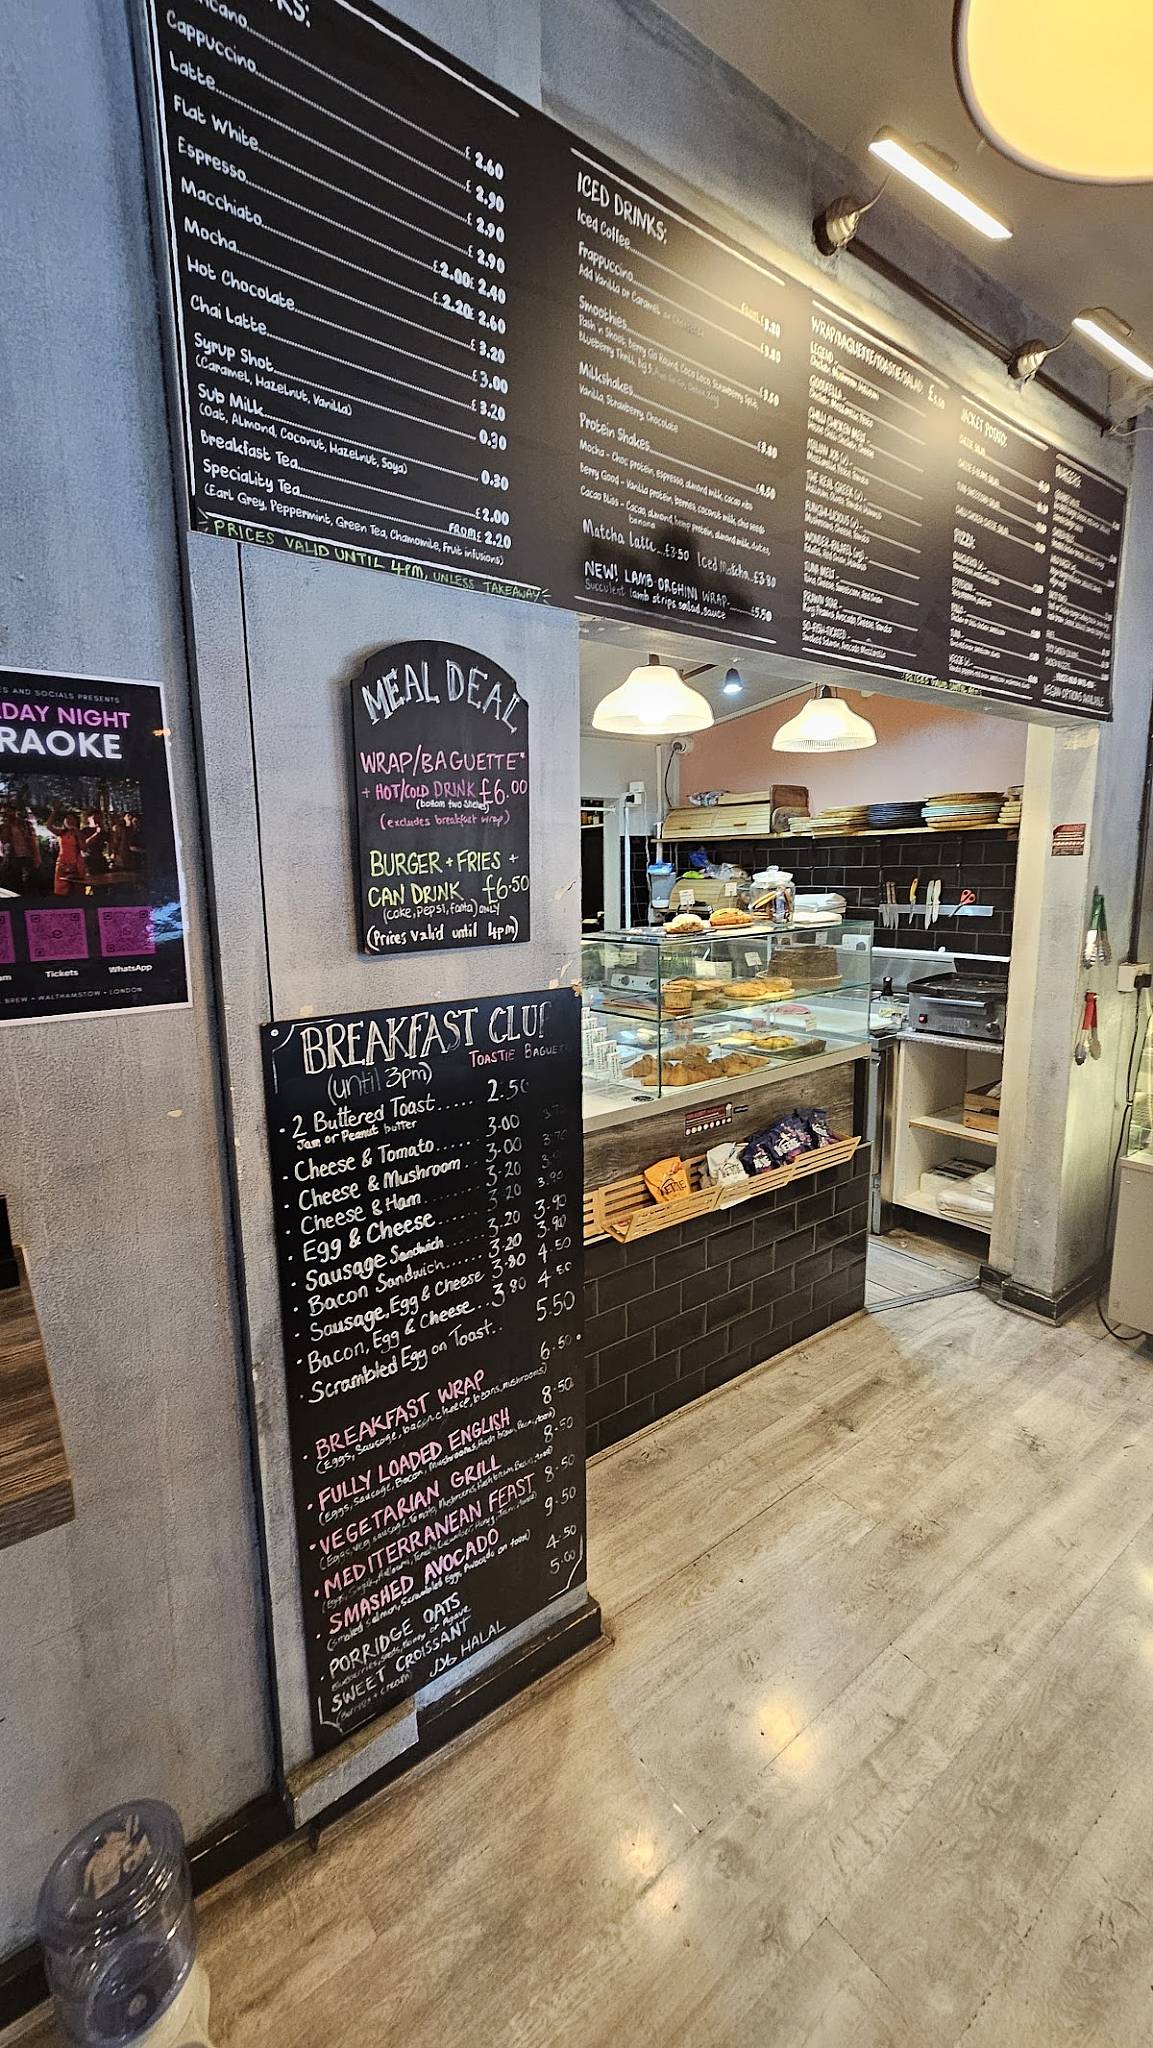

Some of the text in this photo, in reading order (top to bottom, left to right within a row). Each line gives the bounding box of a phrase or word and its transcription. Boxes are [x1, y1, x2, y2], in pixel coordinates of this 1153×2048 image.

[166, 9, 257, 74] Cappuccino
[169, 50, 216, 91] Latte
[173, 95, 259, 152] Flat White
[177, 135, 247, 183] Espresso
[181, 177, 262, 227] Macchiato
[576, 171, 610, 208] ICED
[184, 216, 238, 253] Mocha
[186, 255, 296, 311] Hot Chocolate
[578, 241, 634, 282] Frappuccino
[190, 294, 268, 336] Chai Latte
[578, 294, 627, 330] Smoothies
[194, 332, 507, 451] Syrup Shot 0.30
[312, 393, 352, 417] Vanilla)
[198, 383, 509, 491] Sub Milk 0.30
[579, 412, 615, 438] Protein
[200, 429, 271, 462] Breakfast
[275, 450, 299, 470] Tea
[381, 456, 408, 475] Soya)
[203, 459, 300, 497] Speciality Tea
[335, 516, 367, 533] Green
[582, 518, 625, 545] Matcha
[214, 519, 275, 545] PRICES
[284, 536, 329, 557] VALID
[334, 548, 383, 570] UNTIL
[433, 571, 474, 589] UNLESS
[482, 581, 542, 601] TAKEAWAY
[0, 702, 131, 729] DAY NIGHT
[12, 687, 120, 703] AND SOCIALS PRESENTS
[361, 659, 521, 734] MEAL DEAL
[433, 779, 476, 798] DRINK
[479, 777, 528, 806] £6.00
[380, 810, 511, 831] (excludes breakfast wrap)
[369, 849, 501, 877] BURGER FRIES
[368, 874, 530, 908] CAN DRINK £6.50
[366, 925, 407, 952] (Prices
[452, 921, 478, 938] until
[487, 915, 519, 941] 4pm)
[45, 964, 153, 978] Tickets WhatsApp
[38, 987, 143, 1001] WALTHAMSTOW LONDON
[299, 1006, 479, 1076] BREAKFAST
[469, 1047, 516, 1068] TOASTIE
[327, 1061, 433, 1107] (until 3pm)
[291, 1114, 308, 1139] 2
[313, 1103, 384, 1134] Buttered
[390, 1092, 436, 1117] Toast
[296, 1118, 417, 1151] Jam or Peanut butter
[294, 1157, 356, 1183] Cheese
[380, 1138, 435, 1163] Tomato
[298, 1180, 361, 1211] Cheese
[383, 1158, 461, 1190] Mushroom
[300, 1204, 366, 1235] Cheese
[385, 1191, 421, 1212] Ham
[303, 1239, 342, 1264] Egg
[366, 1211, 436, 1244] Cheese
[305, 1250, 388, 1292] Sausage
[389, 1235, 444, 1265] Sandwich
[307, 1285, 369, 1317] Bacon
[375, 1259, 446, 1292] Sandwich
[389, 1295, 419, 1319] Egg
[435, 1271, 485, 1296] Cheese
[373, 1330, 400, 1354] Egg
[419, 1301, 475, 1329] Cheese
[308, 1355, 398, 1404] Scrambled
[400, 1344, 429, 1372] Egg
[432, 1340, 448, 1356] on
[315, 1369, 485, 1460] BREAKFAST WRAP
[318, 1406, 511, 1512] FULLY LOADED ENGLISH
[319, 1480, 440, 1555] VEGETARIAN
[450, 1454, 502, 1489] GRILL
[323, 1500, 482, 1600] MEDITERRANEAN
[488, 1472, 535, 1512] FEAST
[329, 1574, 414, 1635] SMASHED
[424, 1527, 499, 1583] AVOCADO
[329, 1618, 414, 1679] PORRIDGE
[422, 1591, 461, 1625] OATS
[460, 1620, 506, 1657] HALAL
[331, 1665, 386, 1713] SWEET
[395, 1615, 472, 1673] CROISSANT
